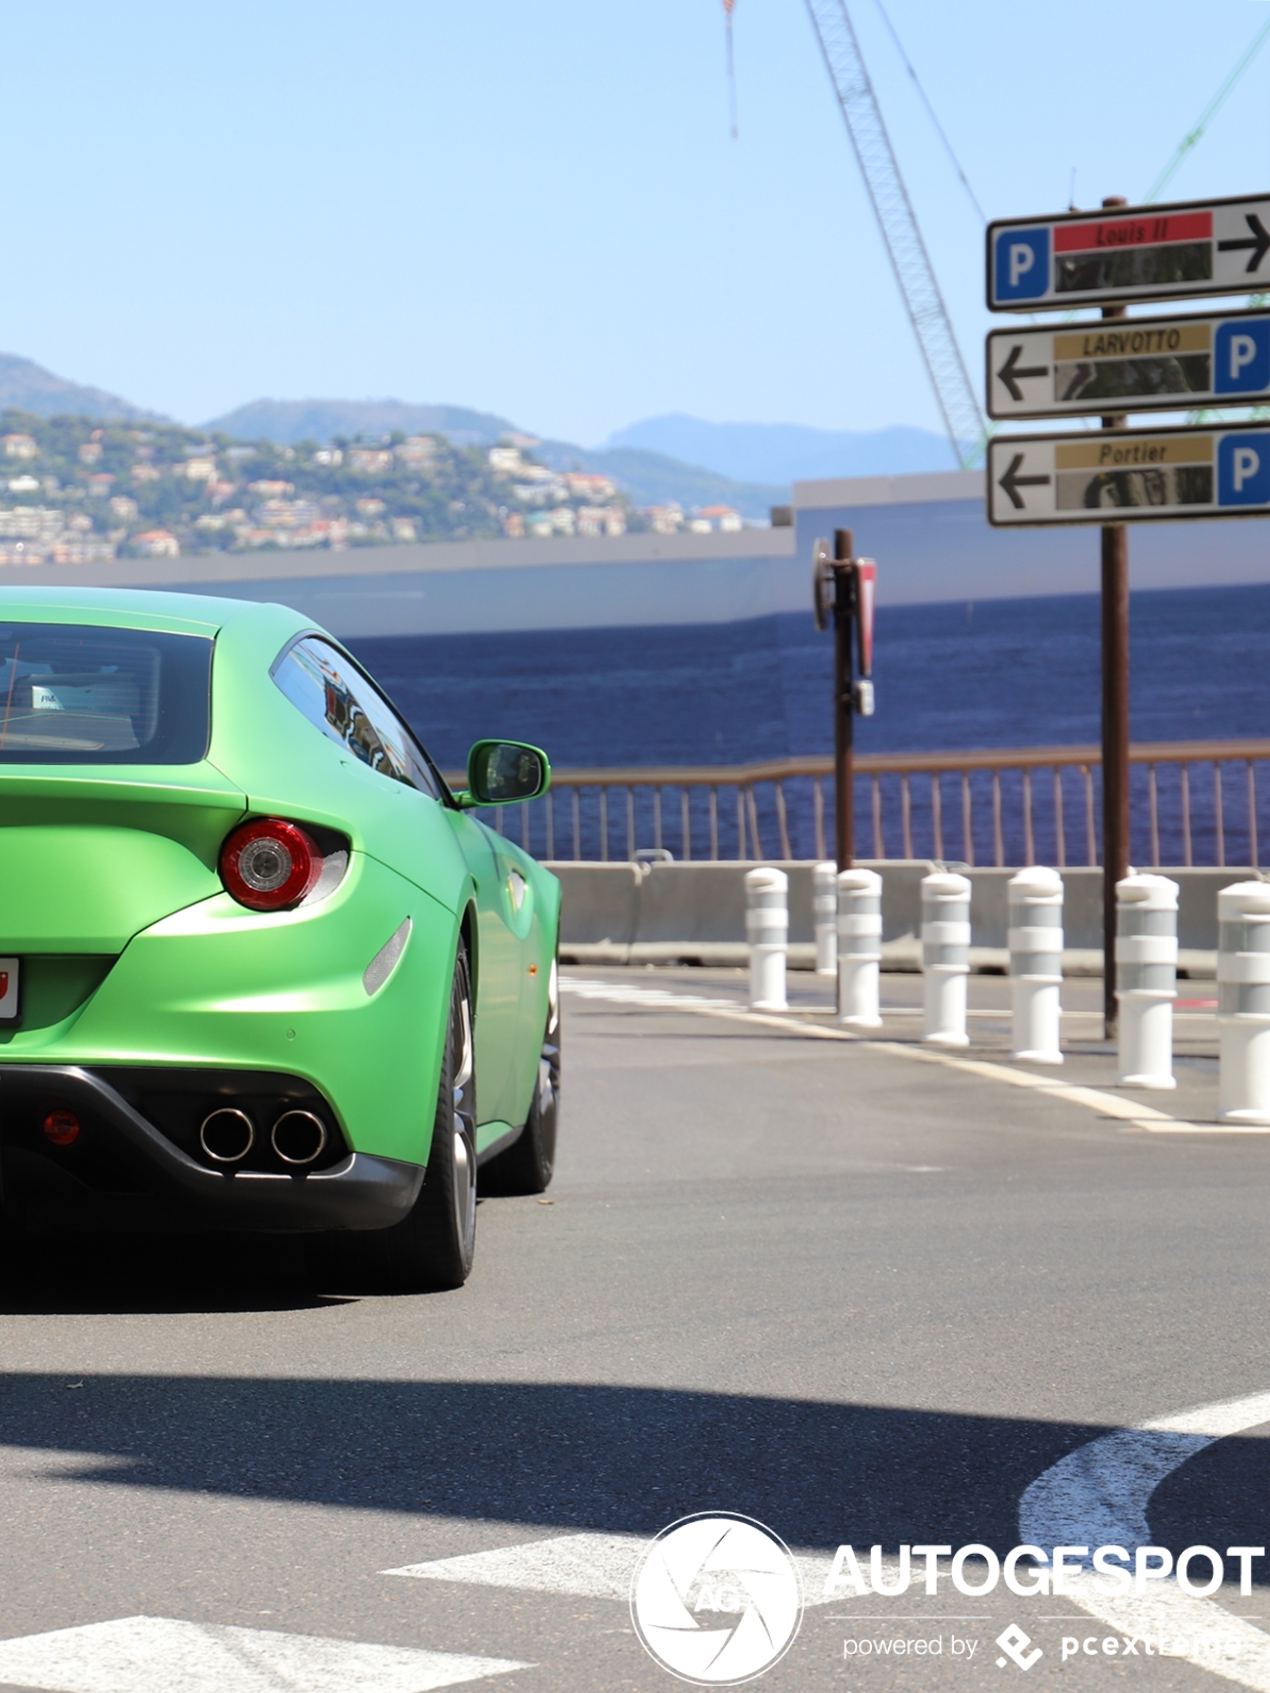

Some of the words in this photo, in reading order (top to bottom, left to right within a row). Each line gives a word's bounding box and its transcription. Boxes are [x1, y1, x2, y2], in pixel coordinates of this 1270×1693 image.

[1009, 243, 1035, 287] P
[1095, 223, 1145, 246] Louis
[1081, 329, 1181, 357] LARVOTTO
[1230, 334, 1257, 379] P
[1098, 441, 1167, 464] Portier
[1233, 447, 1260, 492] P
